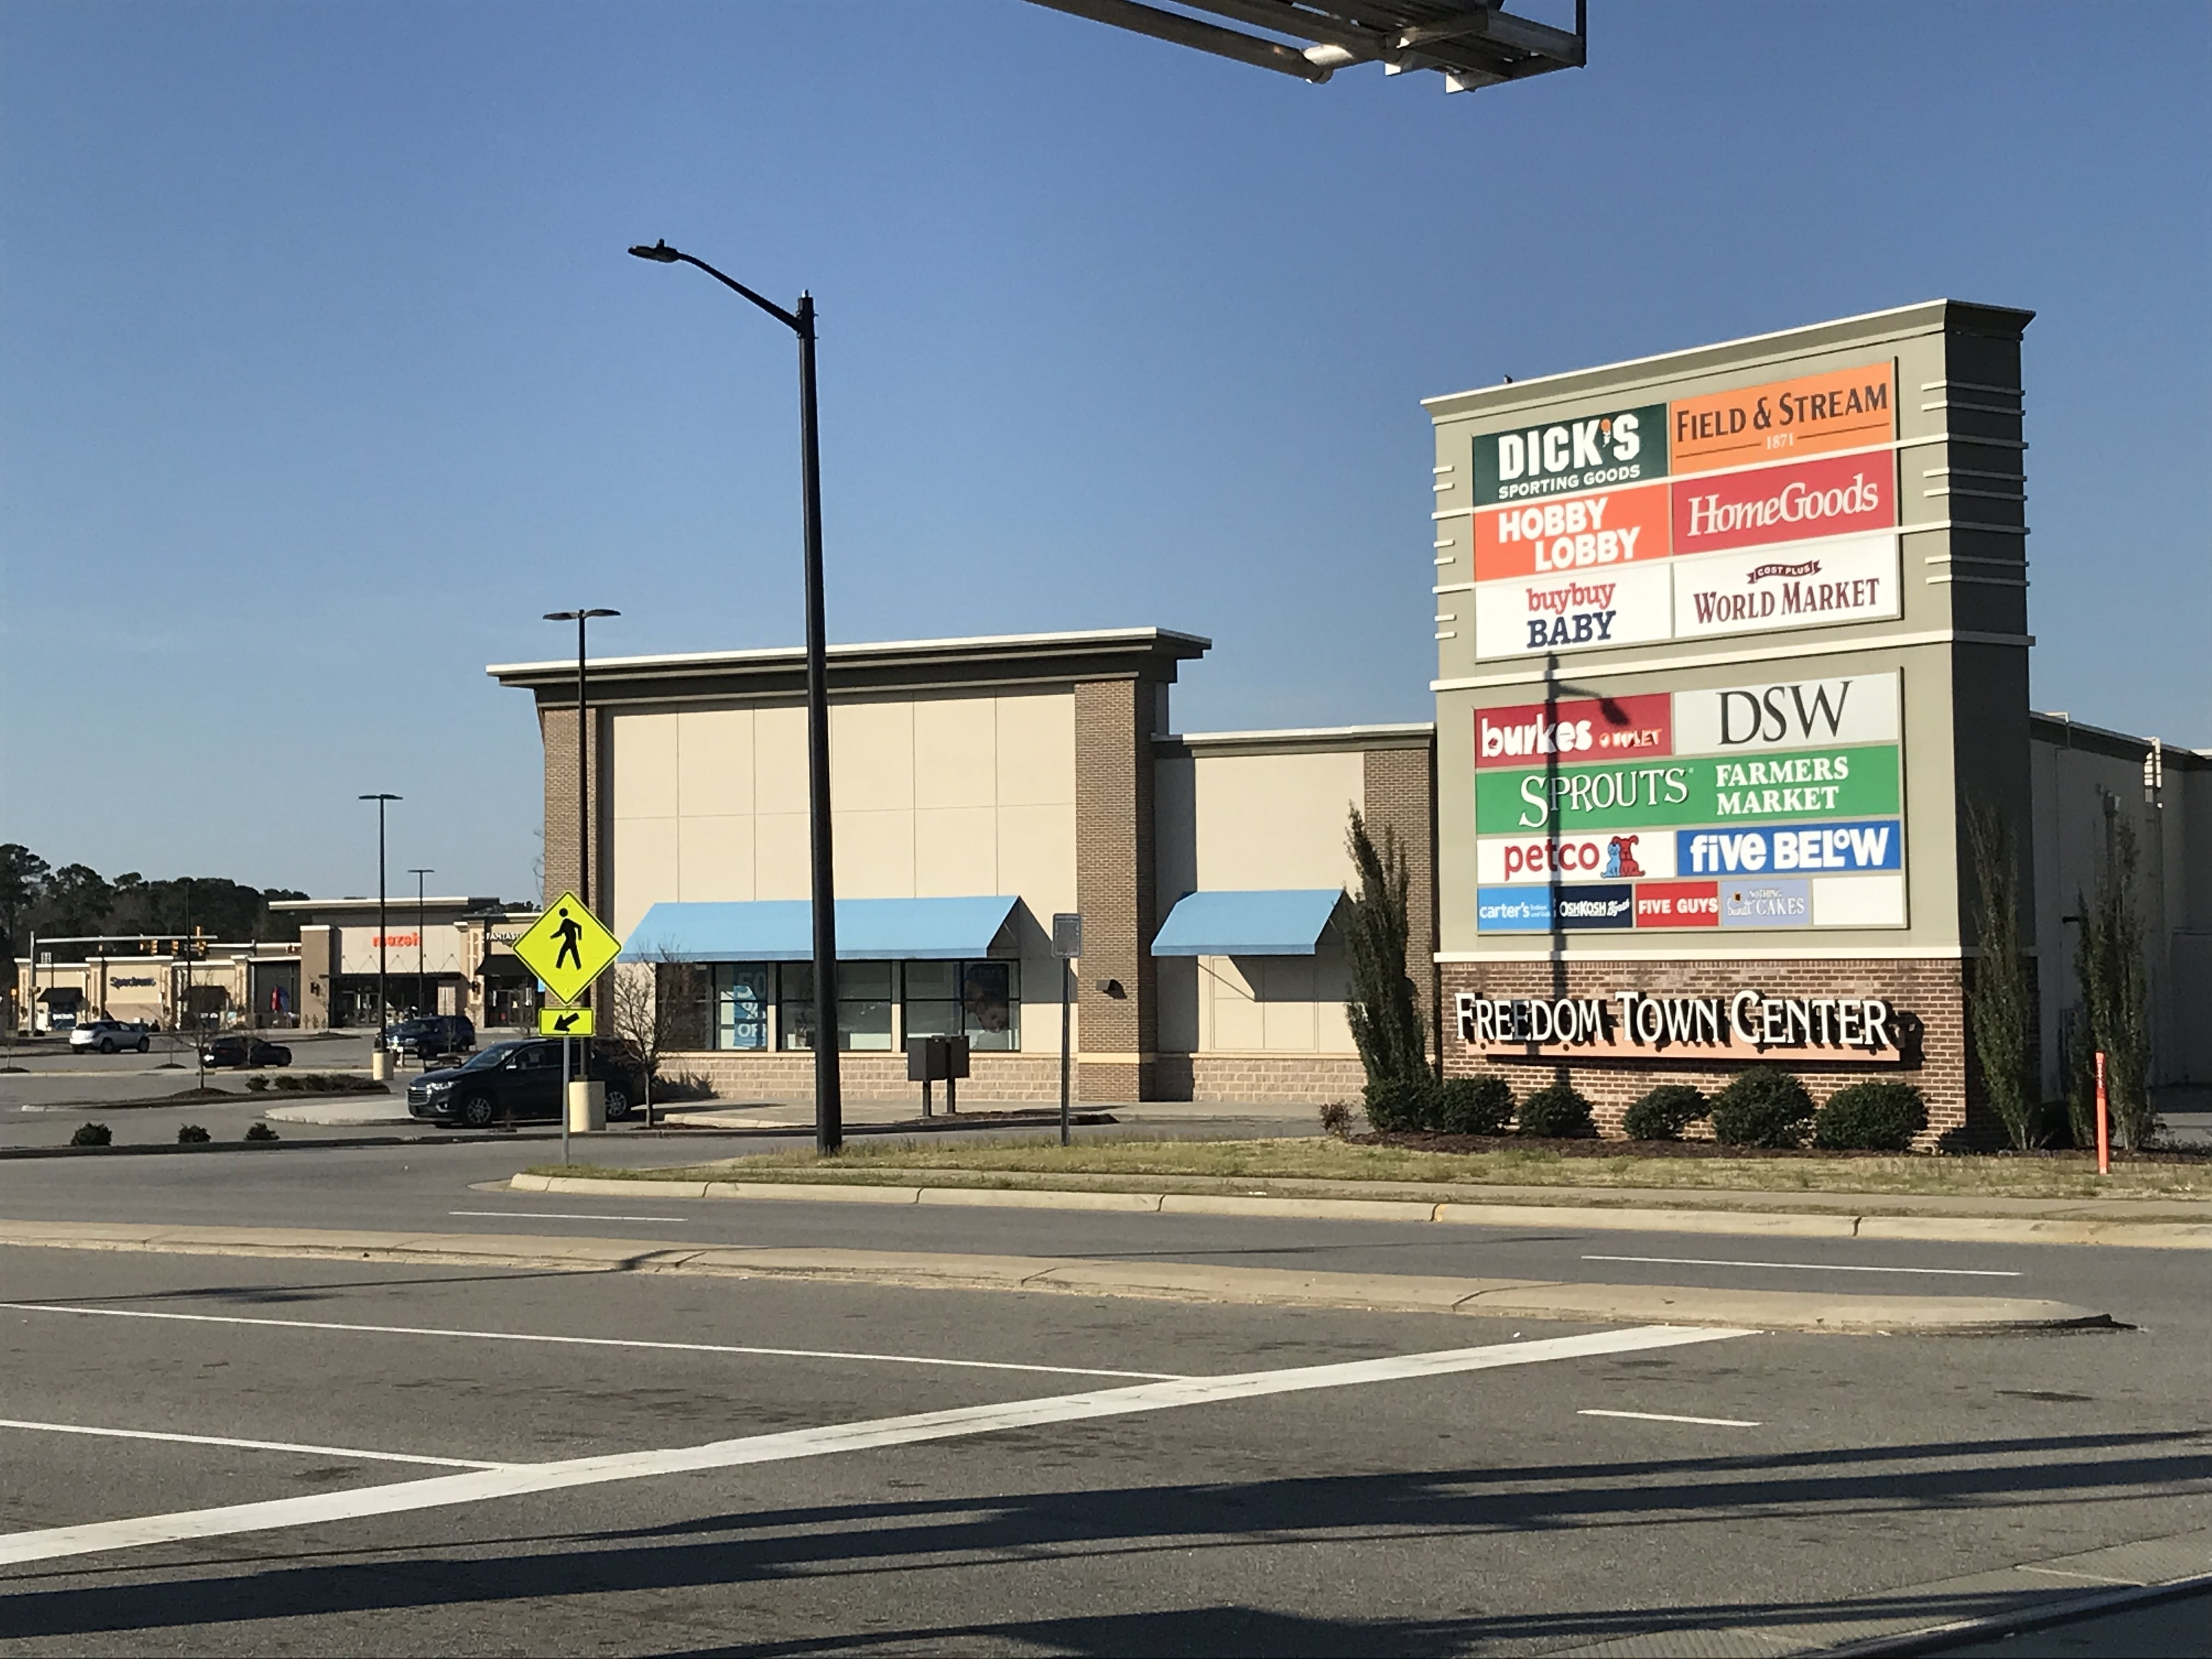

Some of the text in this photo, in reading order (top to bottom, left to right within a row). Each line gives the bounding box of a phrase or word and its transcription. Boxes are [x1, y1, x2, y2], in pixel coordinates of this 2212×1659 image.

[1676, 382, 1888, 442] FIELD & STREAM
[1498, 413, 1640, 481] DICK'S
[1766, 432, 1794, 450] 1871
[1498, 464, 1640, 499] SPORTING GOODS
[1498, 498, 1609, 543] HOBBY
[1687, 473, 1878, 536] HomeGoods
[1534, 527, 1641, 572] LOBBY
[1757, 562, 1811, 576] COST PLUS
[1526, 583, 1616, 615] buybuy
[1694, 578, 1880, 624] WORLD MARKET
[1527, 610, 1616, 648] BABY
[1716, 681, 1853, 745] DSW
[1482, 714, 1592, 757] burkes
[1716, 756, 1849, 788] FARMERS
[1519, 769, 1687, 828] SPROUTS
[1717, 786, 1839, 815] MARKET
[1504, 838, 1600, 881] petco
[1480, 902, 1530, 918] carter's
[1559, 900, 1606, 917] OSHKOSH
[1639, 898, 1718, 915] FIVE GUYS
[1749, 890, 1782, 898] NOTHING
[1756, 898, 1804, 915] CAKES
[486, 932, 523, 940] FANTAST
[1455, 990, 1892, 1045] FREEDOM TOWN CENTER
